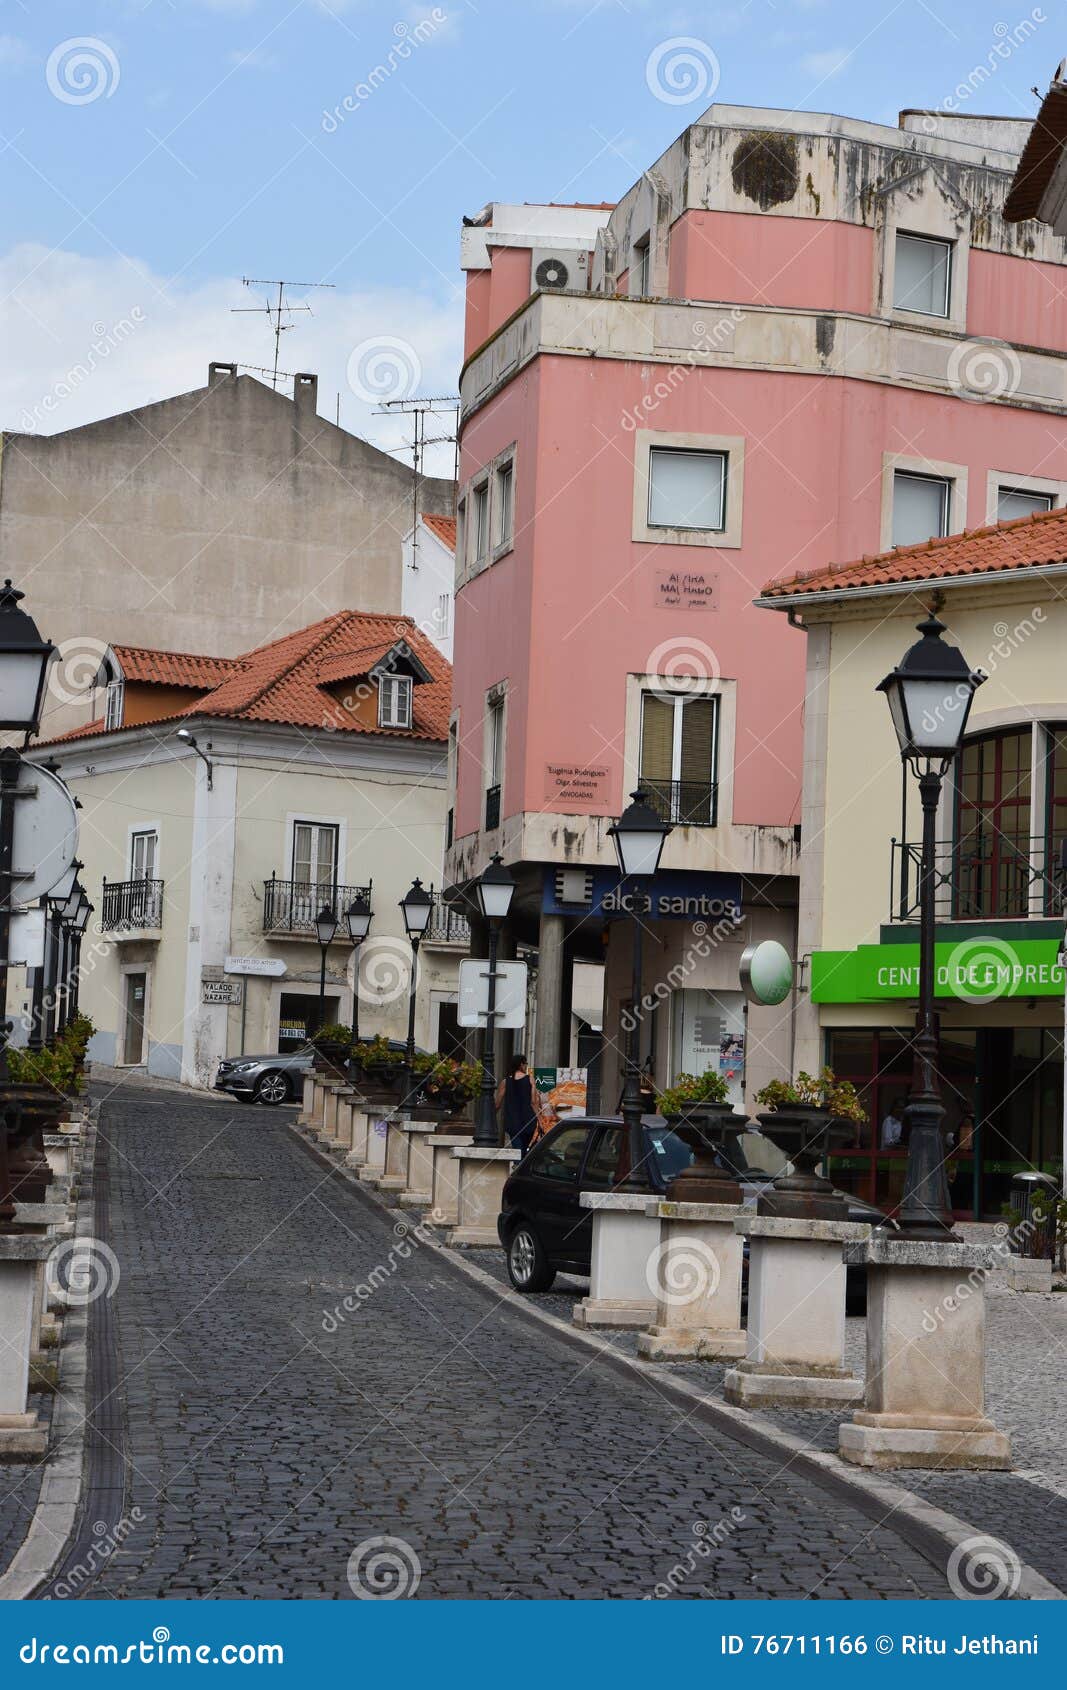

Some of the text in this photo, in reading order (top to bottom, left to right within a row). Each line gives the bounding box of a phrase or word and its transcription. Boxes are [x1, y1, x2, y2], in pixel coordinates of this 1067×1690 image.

[601, 886, 736, 916] alca santos
[878, 963, 1063, 986] CENTO DE EMPREG
